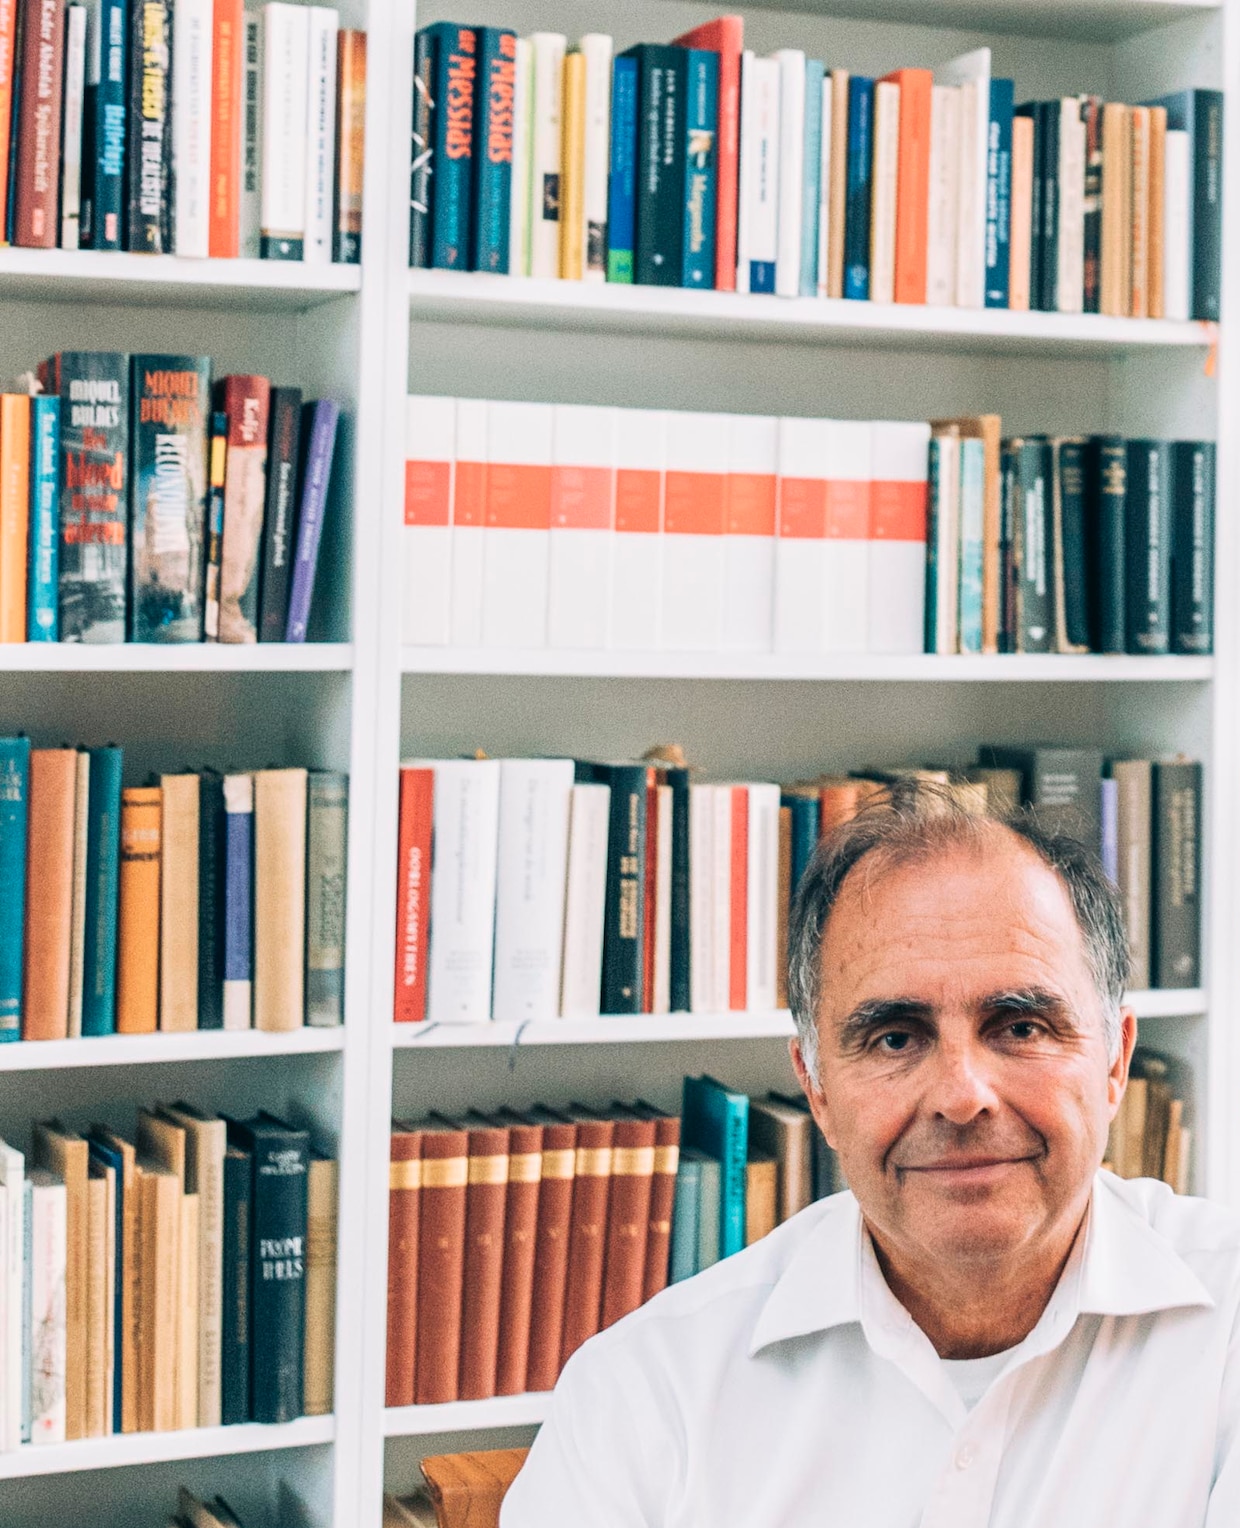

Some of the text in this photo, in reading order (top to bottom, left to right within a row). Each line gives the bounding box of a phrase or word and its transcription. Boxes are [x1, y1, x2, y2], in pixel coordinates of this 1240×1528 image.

[34, 0, 55, 192] Kader Abdolah Spijkerschrift
[446, 54, 476, 160] Messias
[488, 59, 515, 163] Messias
[140, 120, 163, 216] DE IDEALISTEN
[69, 380, 120, 403] MIQUEL
[71, 405, 119, 427] BULNES
[140, 398, 199, 424] BULNES
[145, 370, 199, 397] MIQUEL
[239, 398, 260, 442] Kolja
[66, 451, 123, 489] bloed
[154, 433, 188, 554] RECONQUISTA
[403, 847, 422, 986] OORLOGSMYTHEN
